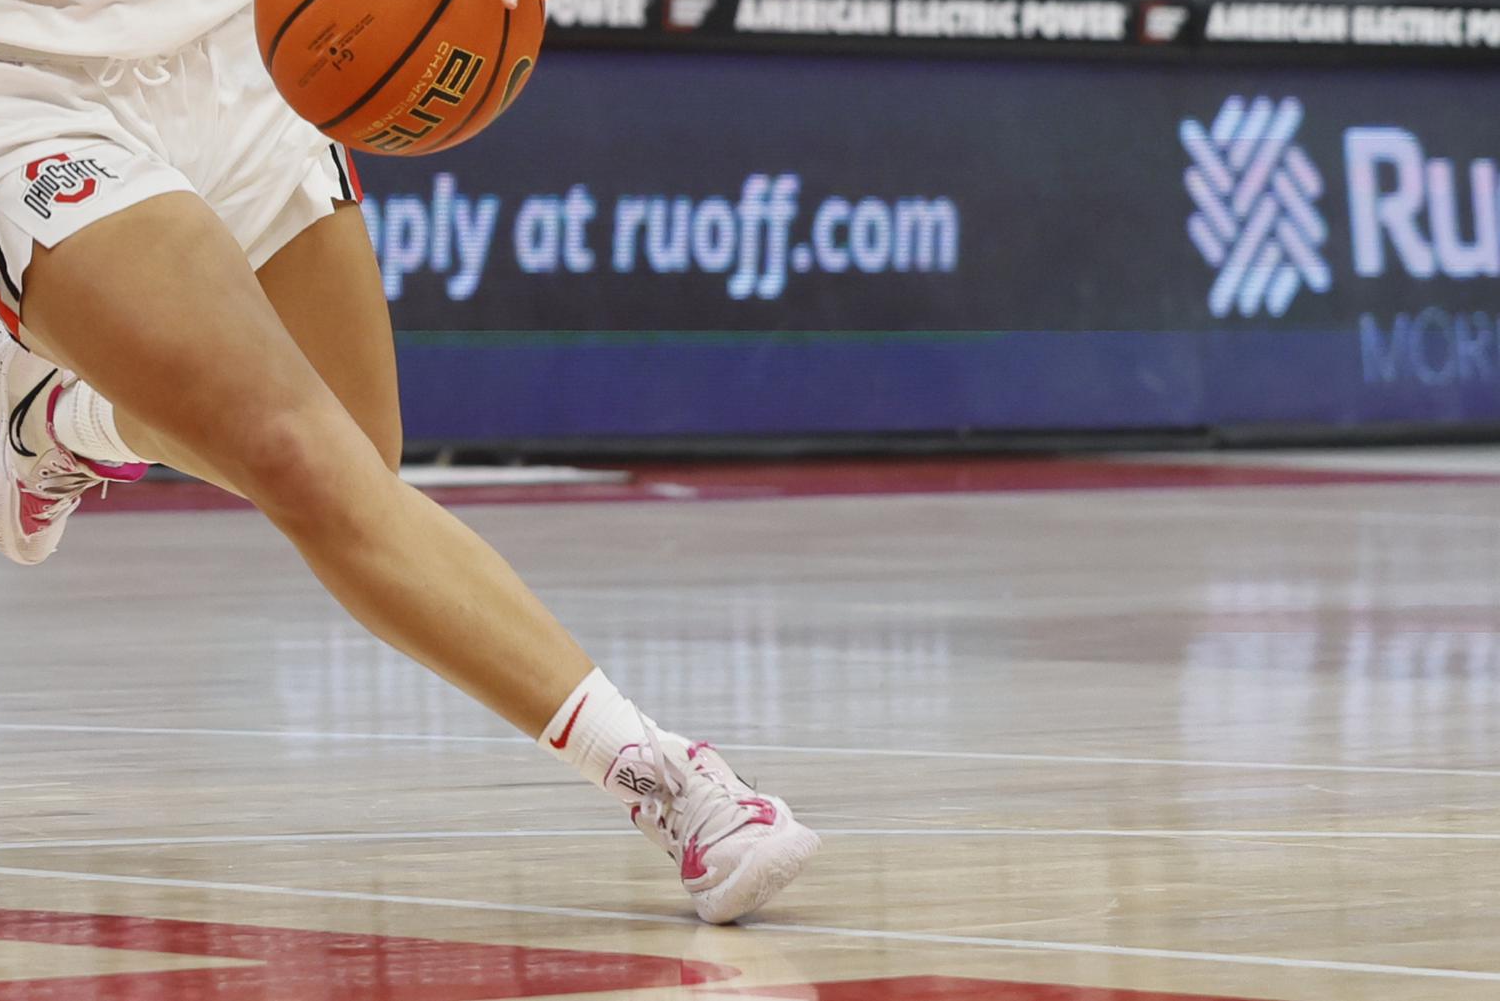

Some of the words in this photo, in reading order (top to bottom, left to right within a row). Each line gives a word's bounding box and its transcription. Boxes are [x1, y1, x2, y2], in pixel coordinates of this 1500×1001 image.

[1020, 0, 1127, 41] POWER
[1205, 1, 1348, 42] AMERICAN
[1350, 5, 1463, 47] ELECTRIC
[513, 183, 597, 273] at
[611, 172, 960, 301] ruoff.com
